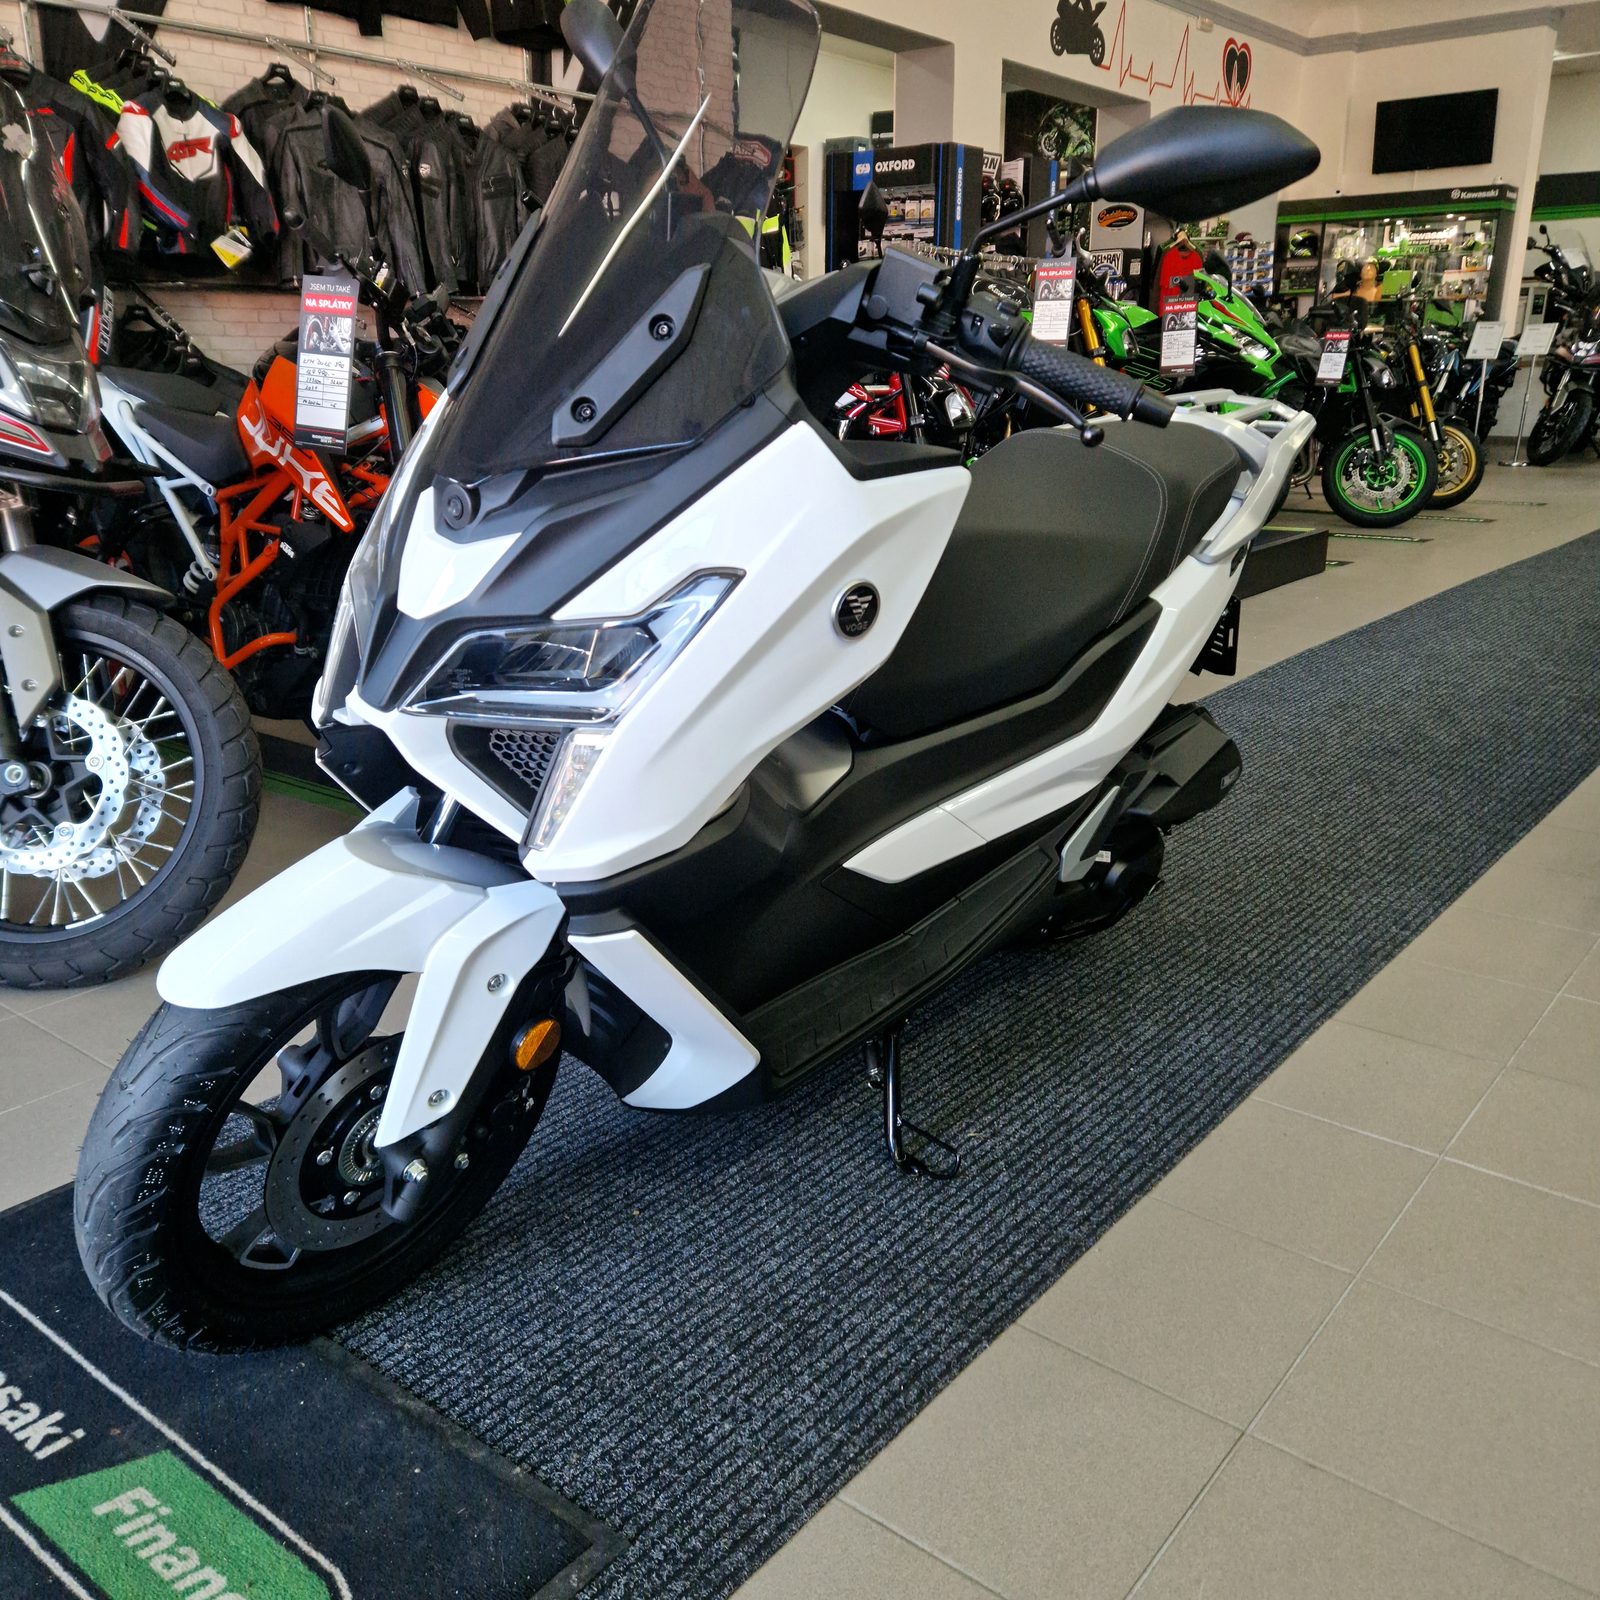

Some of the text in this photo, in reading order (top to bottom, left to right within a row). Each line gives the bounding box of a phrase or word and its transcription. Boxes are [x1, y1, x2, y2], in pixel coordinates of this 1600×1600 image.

[875, 159, 915, 172] OXFORD
[1460, 189, 1499, 199] Kawasaki
[309, 283, 351, 293] JSEM TU TAKÉ
[305, 298, 353, 310] NA SPLÁTKY
[0, 1371, 87, 1461] saki
[91, 1486, 247, 1600] Finan
